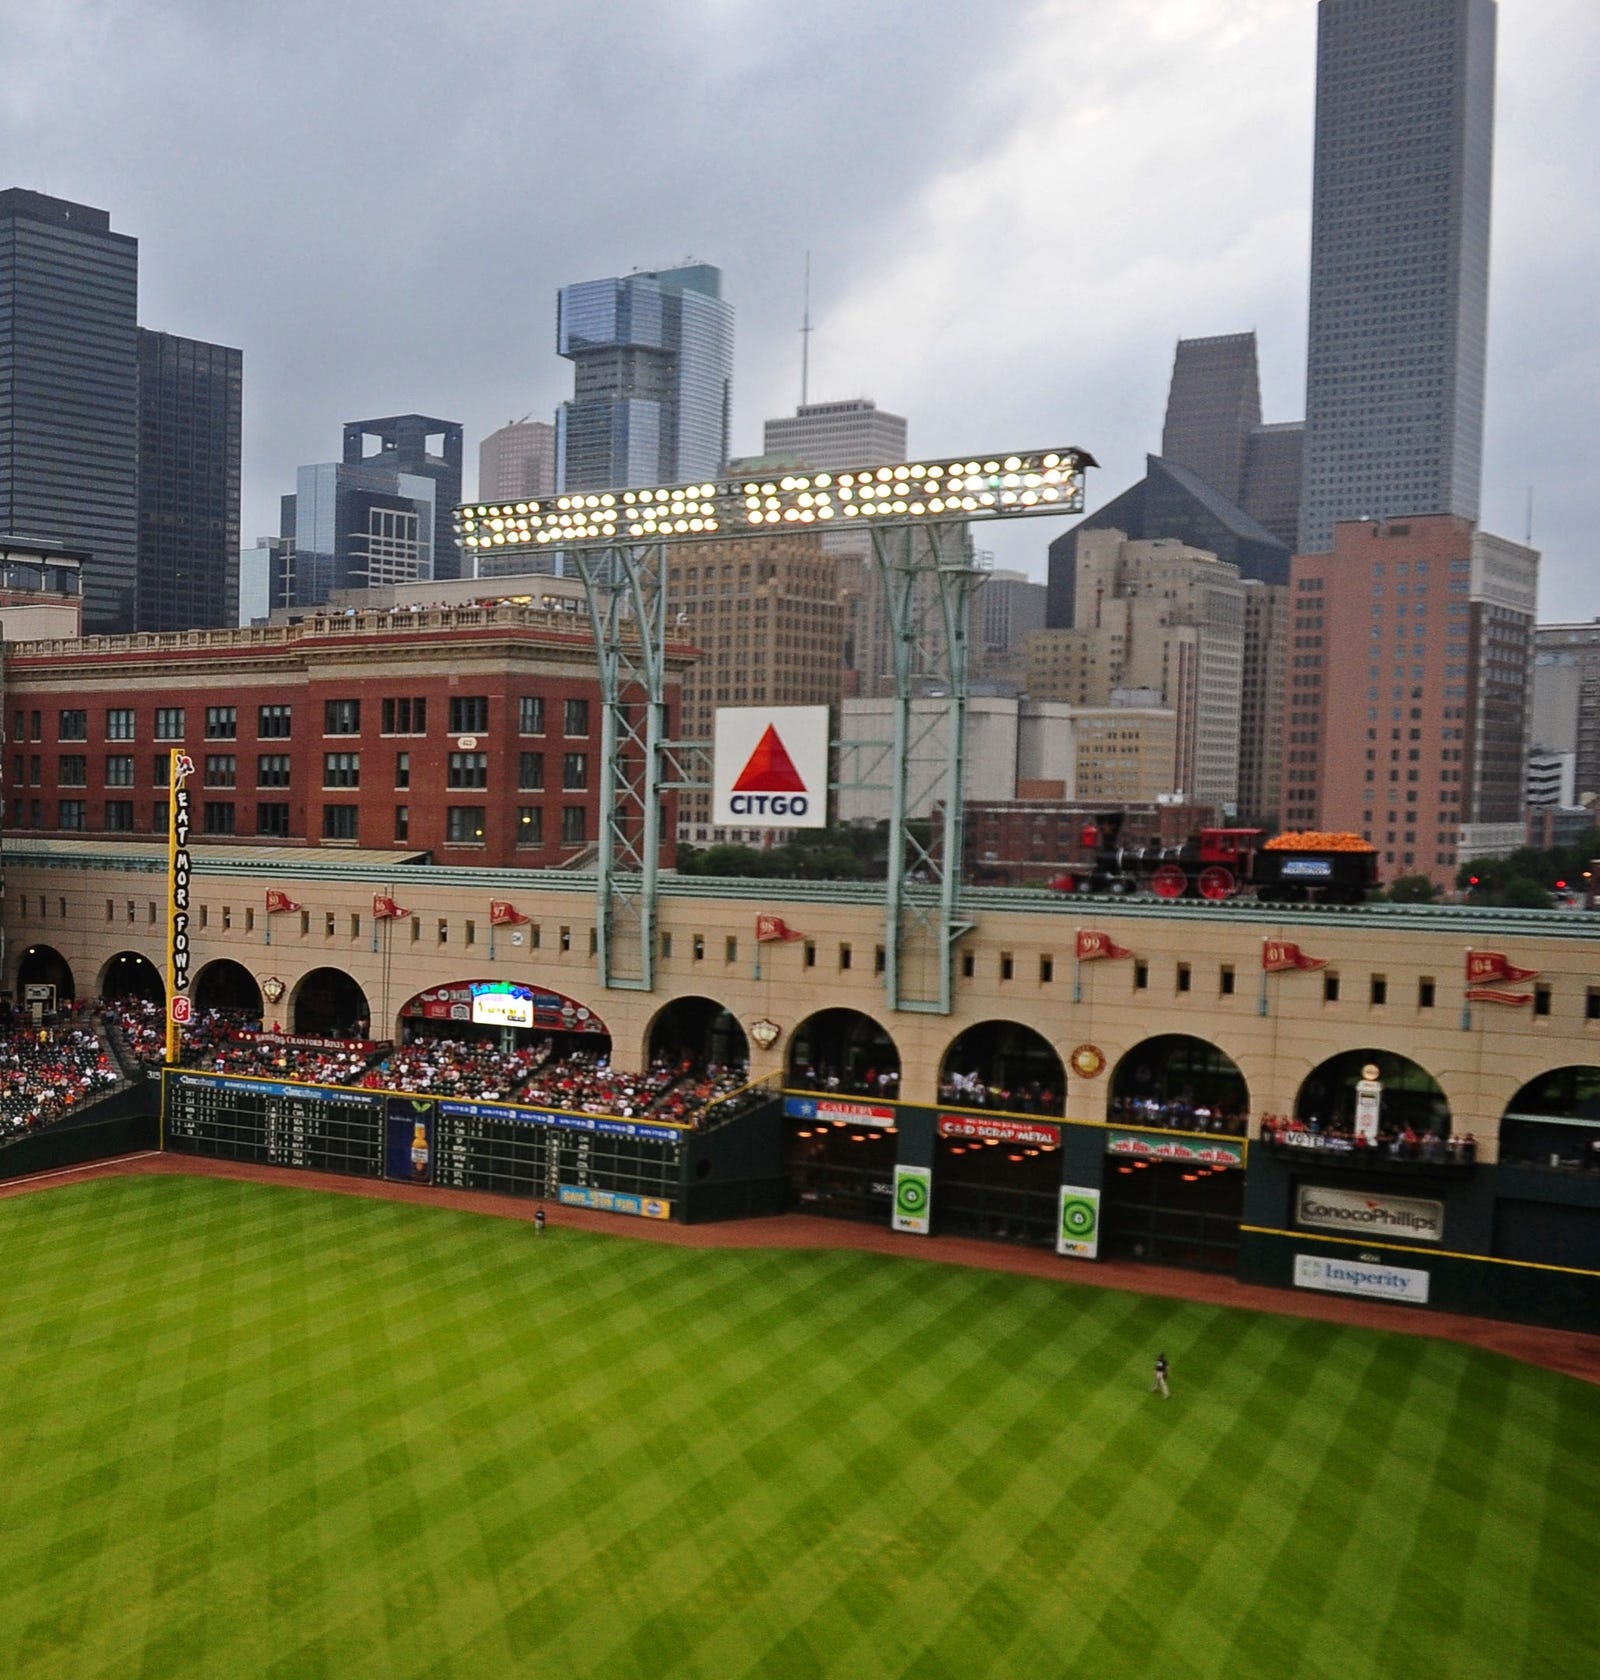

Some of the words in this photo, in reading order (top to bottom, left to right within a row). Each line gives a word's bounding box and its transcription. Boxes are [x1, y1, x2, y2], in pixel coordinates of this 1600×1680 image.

[730, 795, 808, 816] CITGO
[177, 791, 188, 844] EAT
[177, 853, 189, 906] MOR
[176, 916, 188, 987] FOWL
[1081, 937, 1099, 952] 99
[1269, 948, 1286, 961] 01
[147, 1070, 161, 1080] 315
[442, 1104, 469, 1112] UNITED
[481, 1108, 508, 1117] UNITED
[520, 1113, 546, 1122] UNITED
[560, 1118, 586, 1126] UNITED
[599, 1123, 627, 1132] UNITED
[640, 1128, 668, 1137] UNITED
[978, 1127, 1015, 1138] SCRAP
[1016, 1131, 1054, 1143] METAL
[1302, 1200, 1437, 1231] ConocoPhillips
[1325, 1262, 1410, 1292] Insperity
